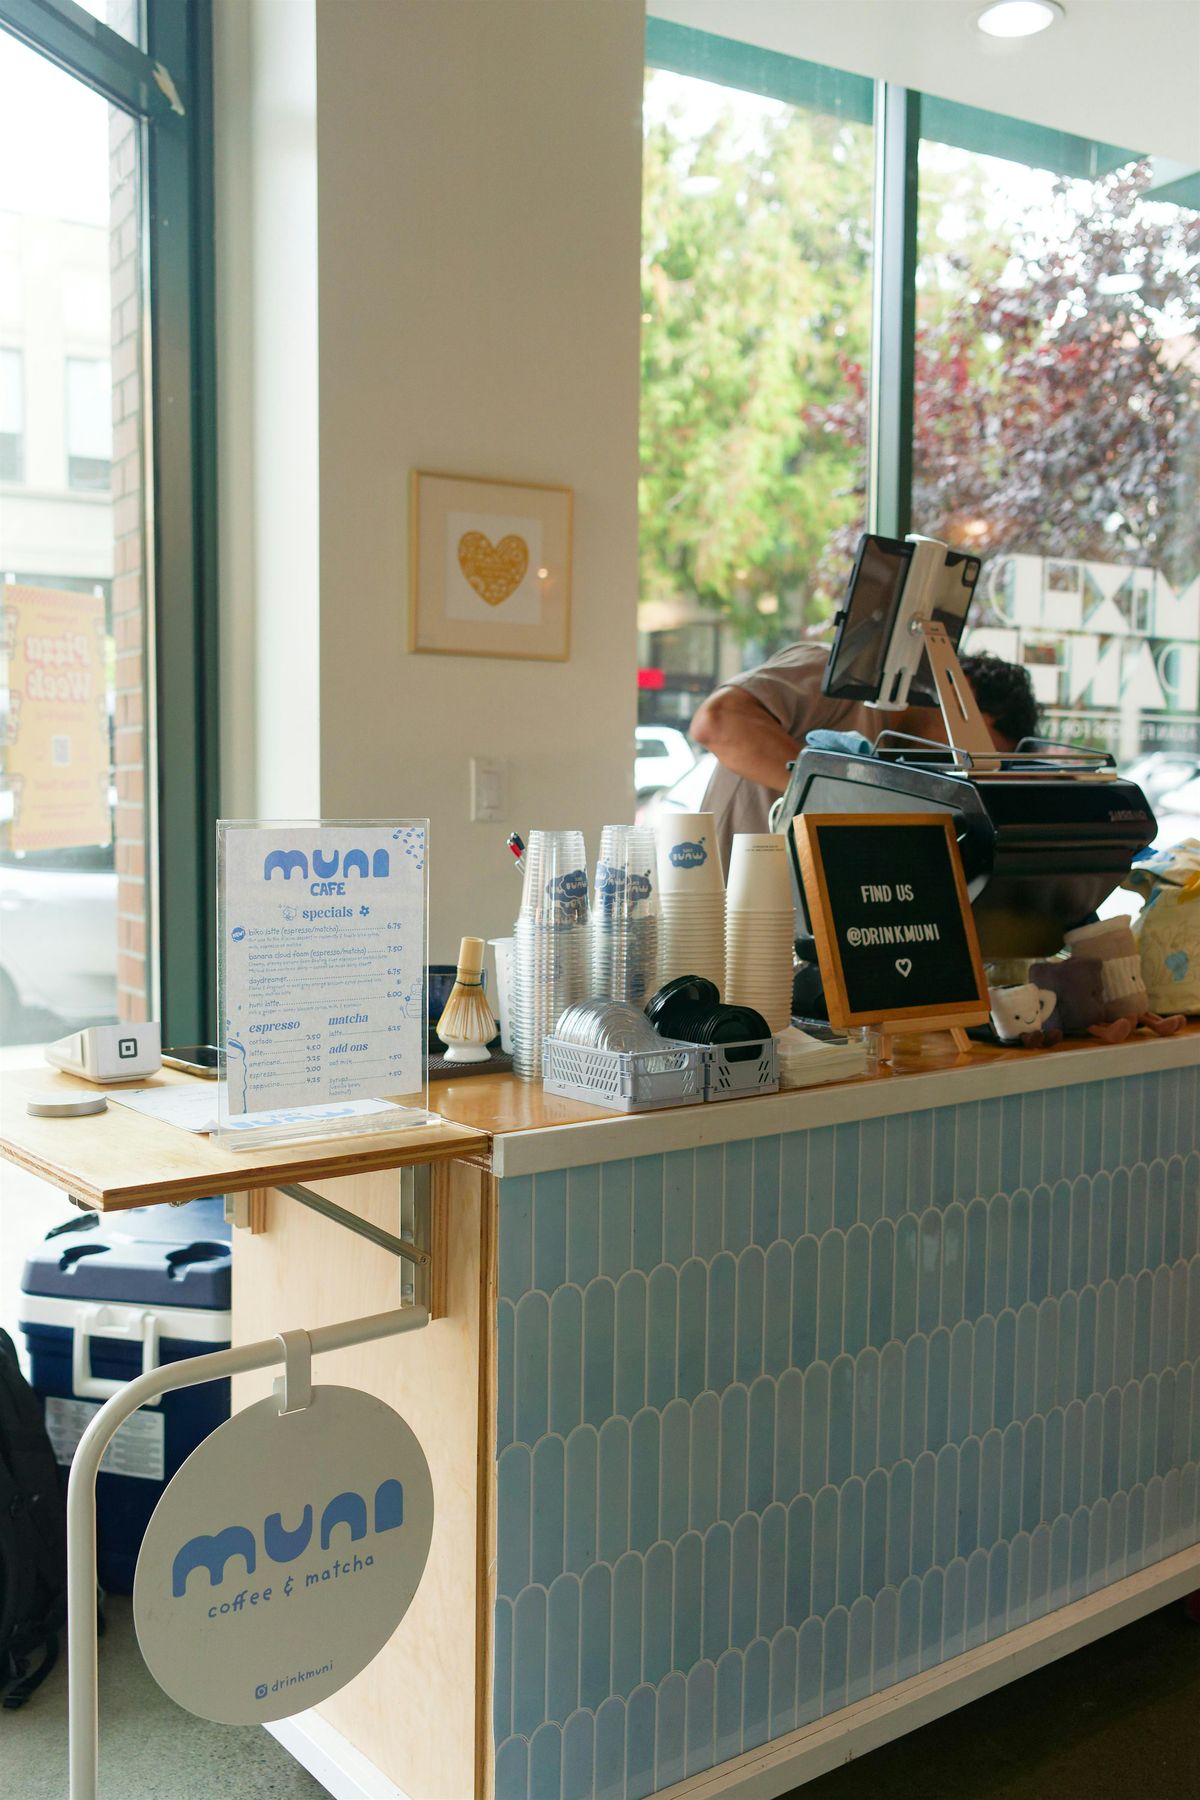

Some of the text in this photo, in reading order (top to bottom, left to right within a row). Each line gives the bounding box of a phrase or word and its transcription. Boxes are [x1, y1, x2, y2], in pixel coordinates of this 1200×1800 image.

[310, 882, 346, 896] CAFE
[860, 884, 914, 903] FIND US
[302, 906, 353, 920] specials
[847, 923, 940, 947] @DRINKMUNI
[249, 976, 287, 986] daydreamer
[328, 1013, 369, 1025] matcha
[249, 1021, 301, 1034] espresso
[329, 1043, 369, 1054] add ons
[207, 1554, 374, 1618] coffee & matcha
[271, 1660, 334, 1693] drinkmuni
